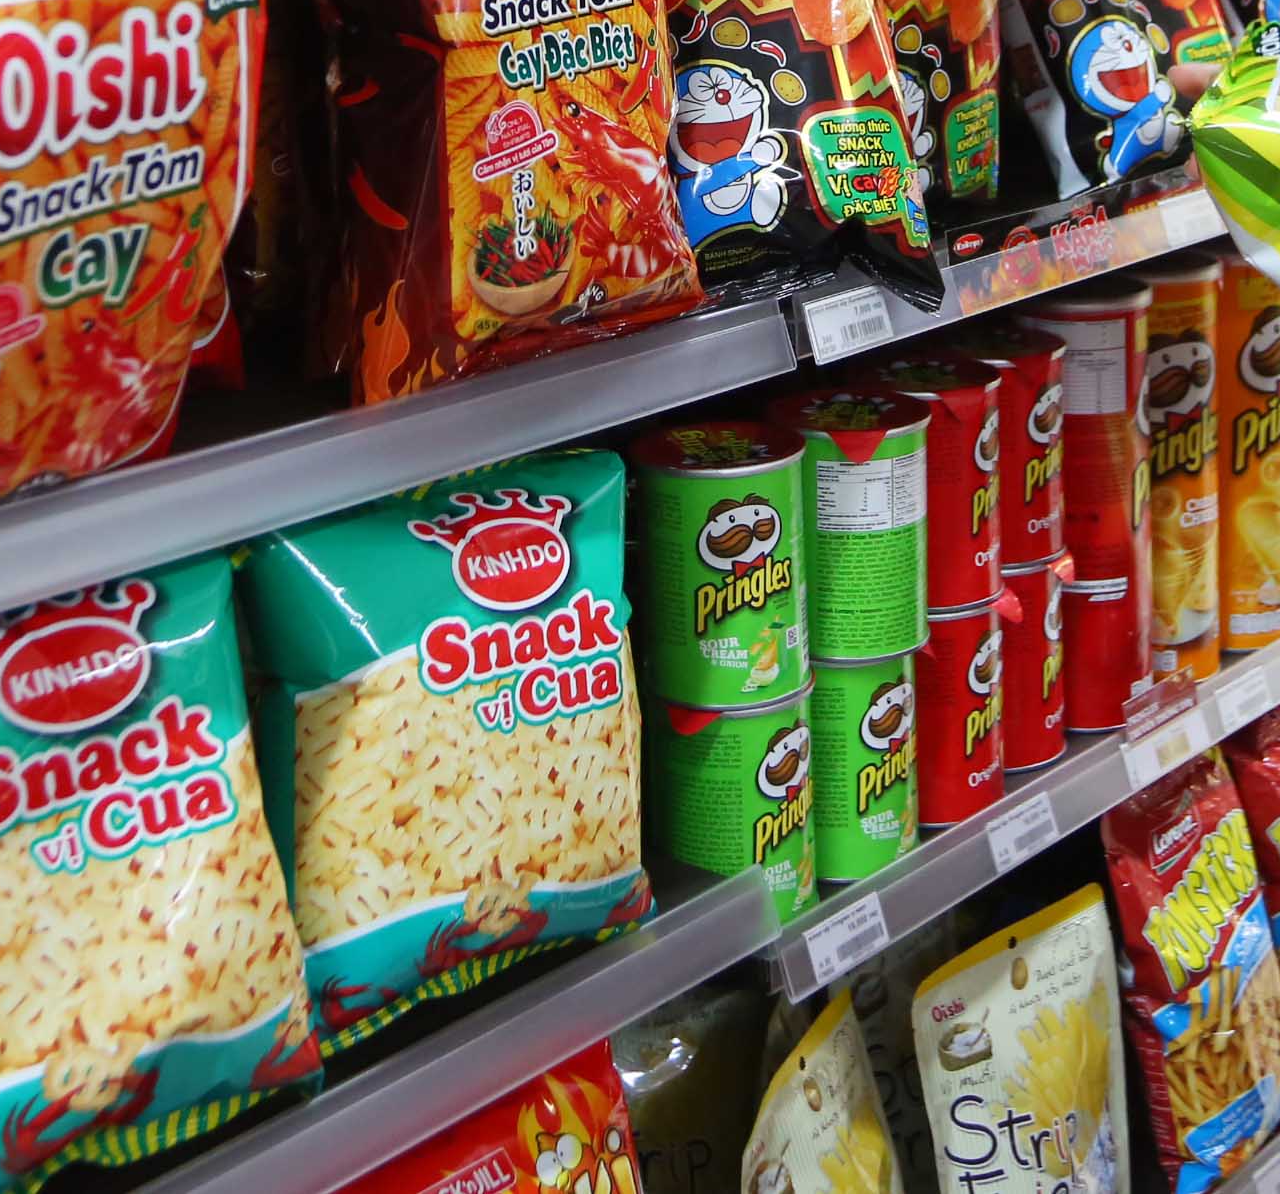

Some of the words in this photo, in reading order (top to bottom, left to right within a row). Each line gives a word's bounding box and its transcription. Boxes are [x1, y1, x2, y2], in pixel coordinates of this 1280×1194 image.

[498, 38, 544, 89] Cay
[543, 31, 586, 83] Đặc
[587, 23, 635, 70] Biệt
[820, 118, 866, 135] Thưởng
[867, 119, 891, 133] thức
[837, 136, 883, 151] SNACK
[120, 146, 200, 198] Tôm
[826, 153, 871, 169] KHOAI
[871, 151, 895, 167] TÂY
[826, 173, 852, 198] Vị
[514, 170, 535, 259] おいしい
[843, 200, 873, 218] ĐẶC
[873, 196, 897, 215] BIỆT
[40, 223, 148, 305] Cay
[696, 556, 792, 634] Pringles
[422, 593, 618, 687] Snack
[699, 636, 741, 651] SOUR
[702, 647, 749, 662] CREAM
[718, 659, 749, 669] ONION
[481, 693, 513, 730] vị
[518, 667, 621, 718] Cua
[35, 827, 85, 870] vị
[85, 775, 231, 855] Cua
[861, 809, 895, 827] SOUR
[1152, 813, 1199, 856] Lorenz
[931, 998, 966, 1024] Oishi
